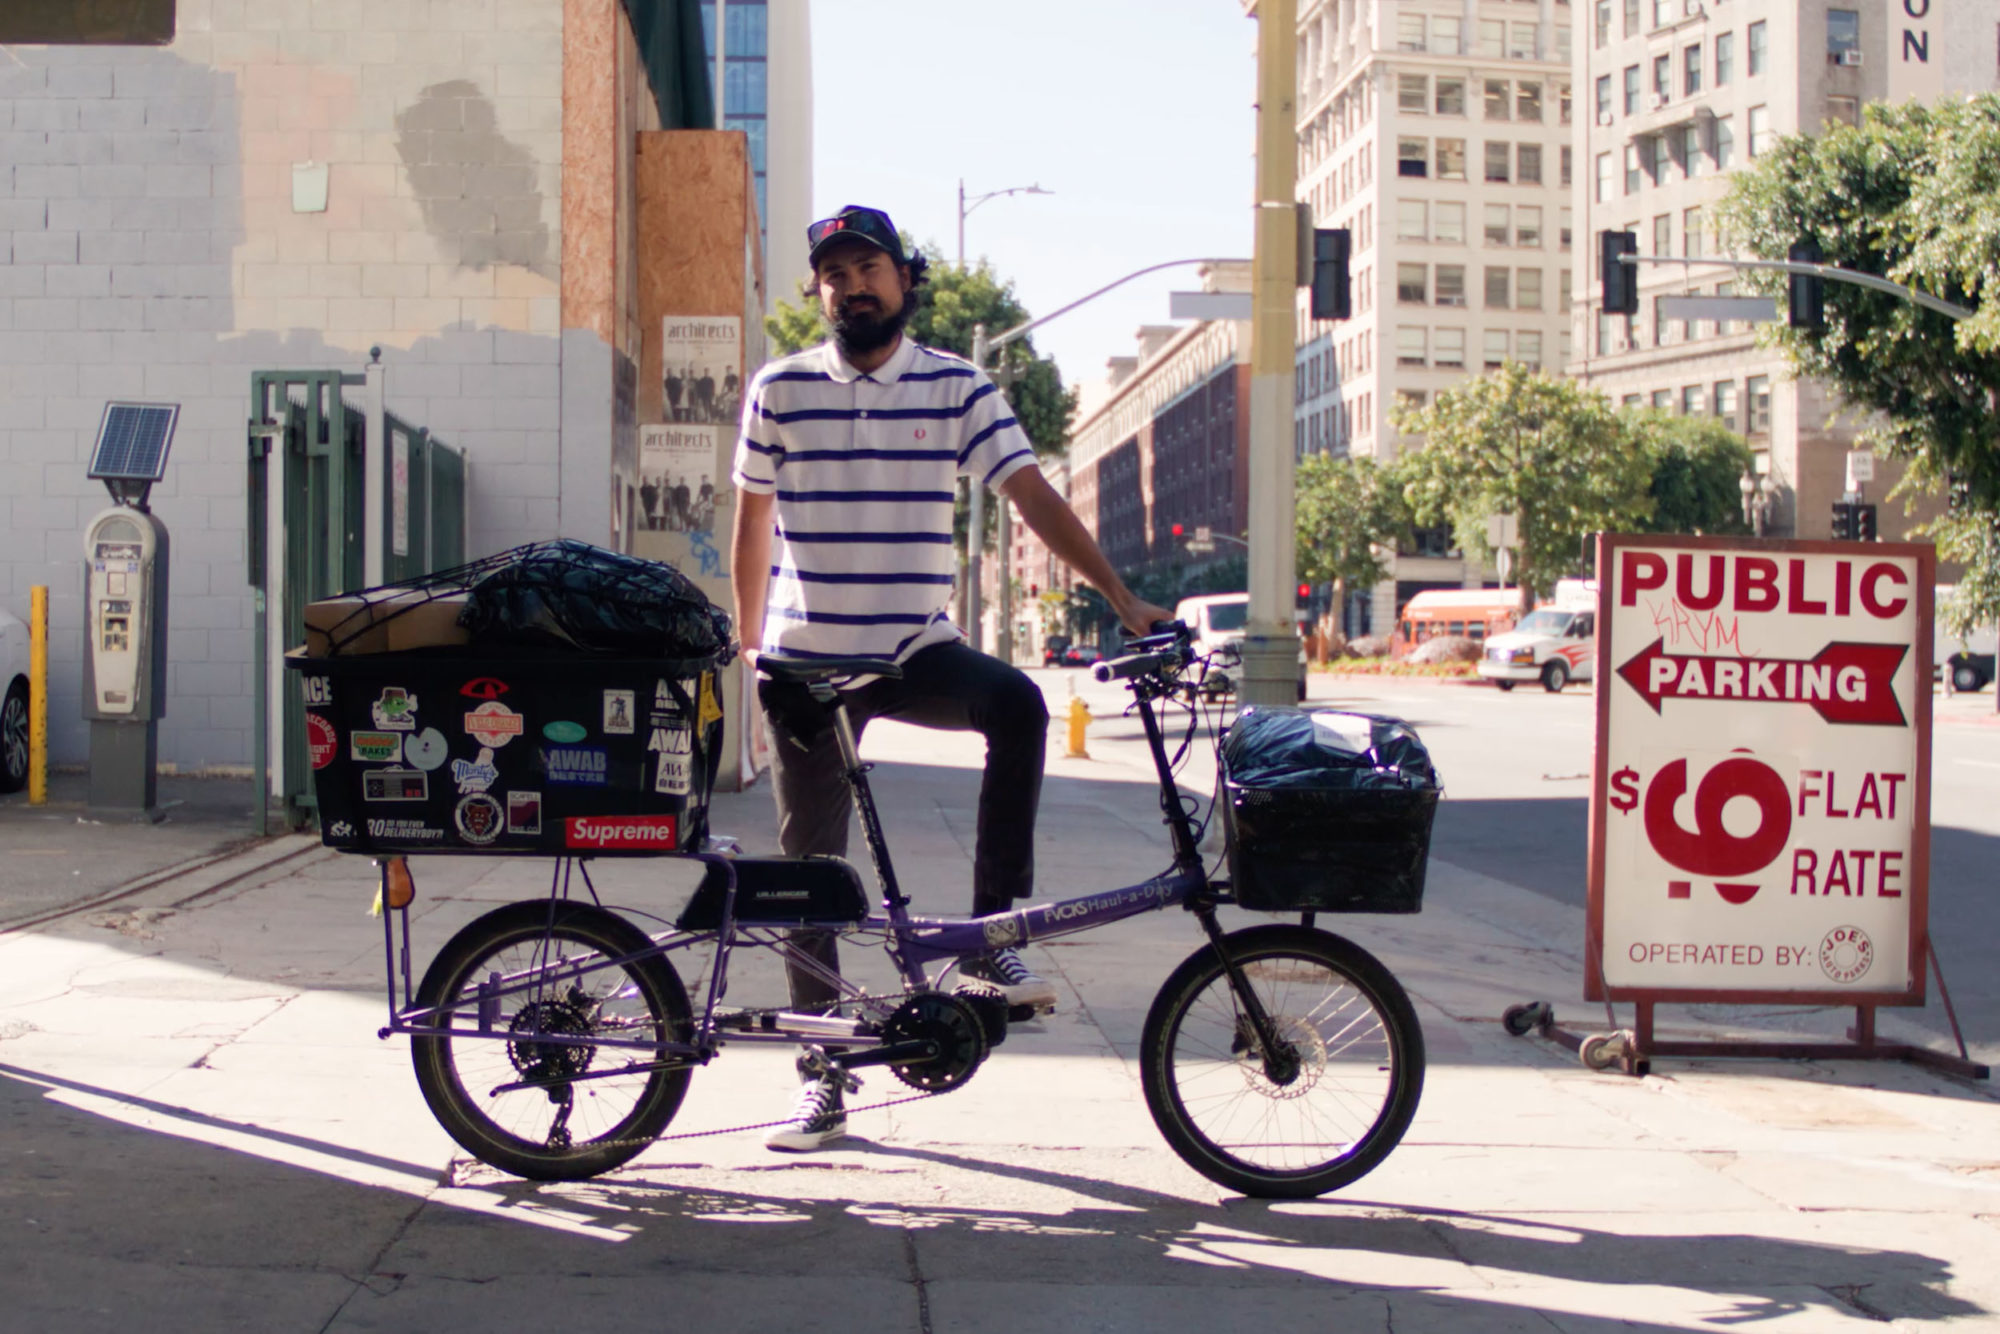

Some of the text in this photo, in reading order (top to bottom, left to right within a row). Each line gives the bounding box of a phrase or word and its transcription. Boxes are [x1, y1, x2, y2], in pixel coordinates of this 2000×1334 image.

[668, 322, 736, 339] architects
[645, 431, 713, 448] architects
[1620, 551, 1908, 620] PUBLIC
[1649, 657, 1867, 702] PARKING
[548, 749, 606, 771] AWAB
[1798, 769, 1906, 820] FLAT
[574, 819, 669, 845] Supreme
[1790, 849, 1903, 897] RATE
[1088, 883, 1174, 912] Haul-a-Day
[1629, 942, 1812, 966] OPERATED BY:
[1826, 929, 1870, 953] JOE'S
